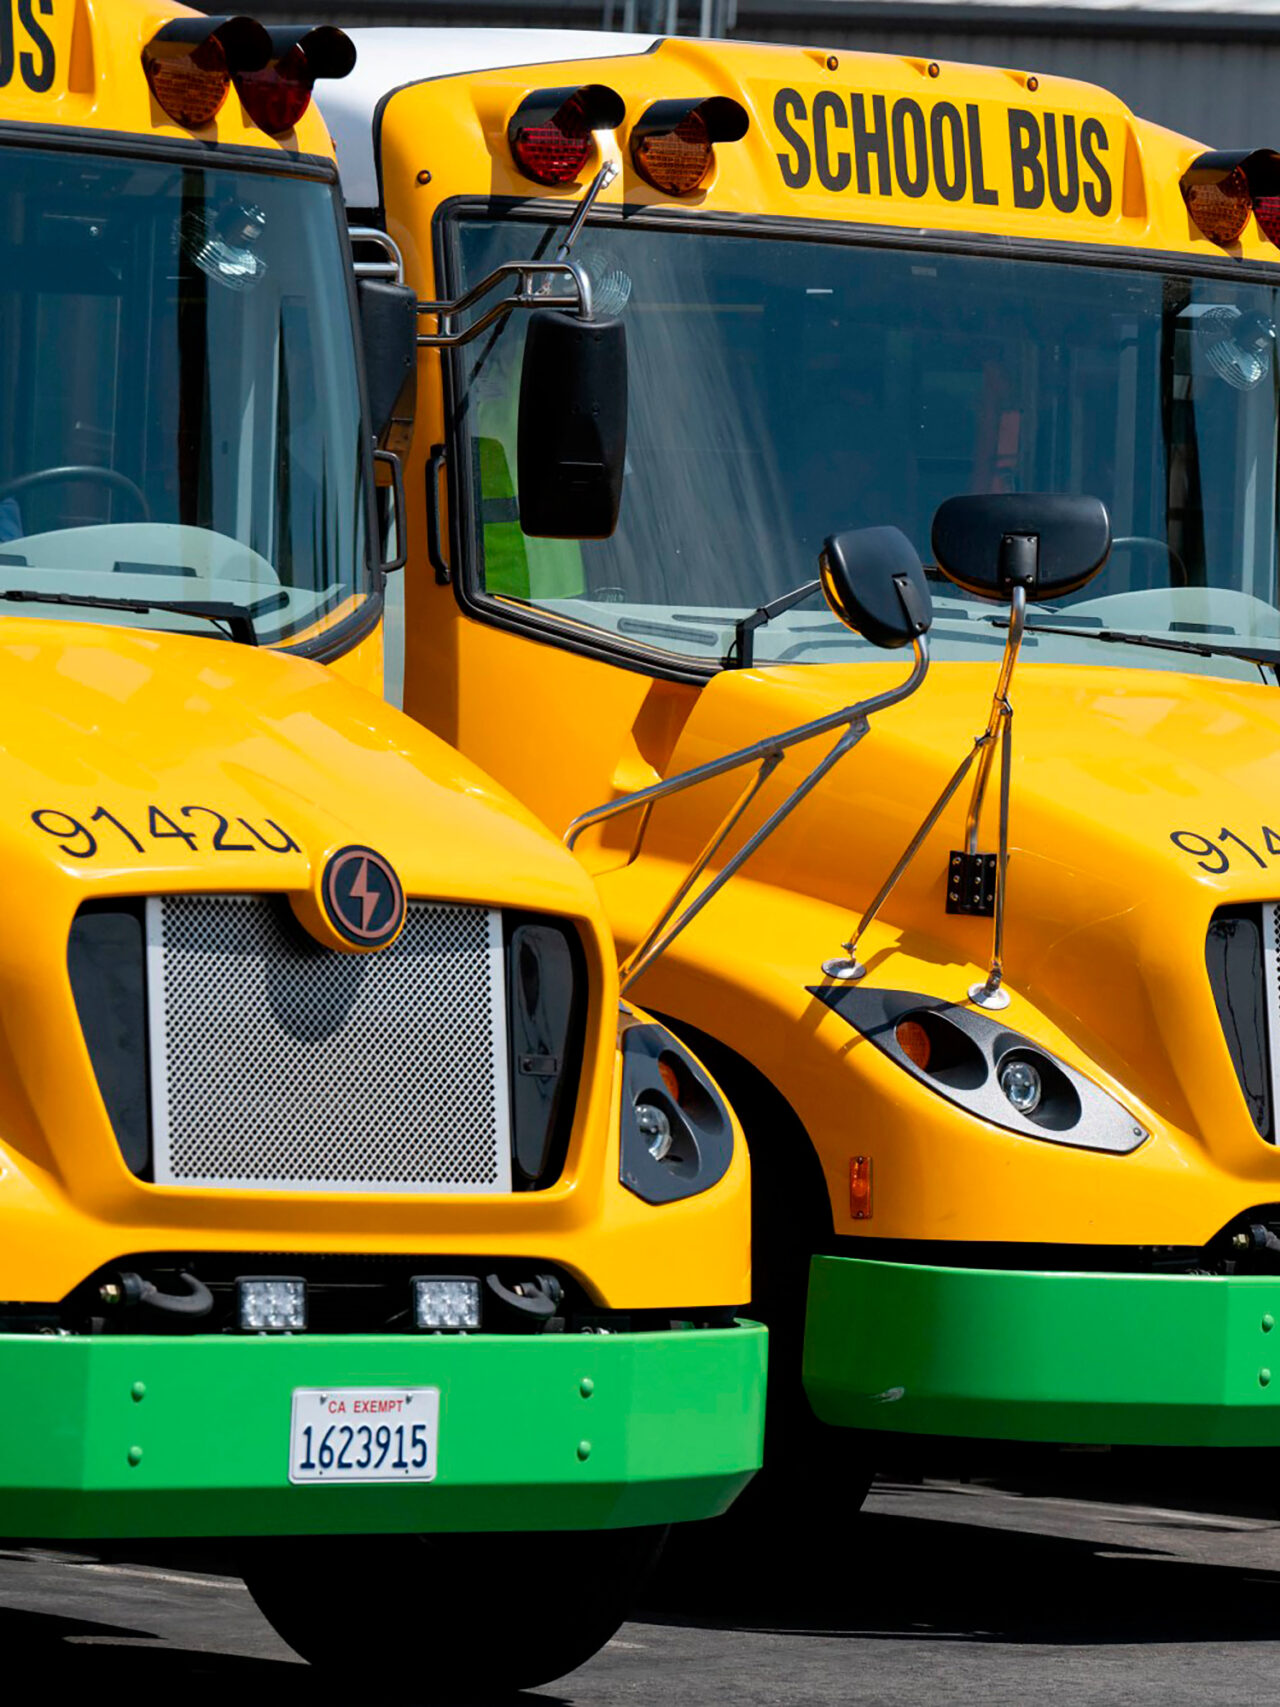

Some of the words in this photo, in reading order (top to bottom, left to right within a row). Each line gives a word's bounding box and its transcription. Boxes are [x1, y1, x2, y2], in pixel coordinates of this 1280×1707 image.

[773, 87, 999, 206] SCHOOL
[1007, 108, 1112, 218] BUS
[31, 805, 303, 859] 9142u
[328, 1400, 346, 1414] CA
[353, 1399, 405, 1413] EXEMPT
[300, 1424, 428, 1469] 1623915
